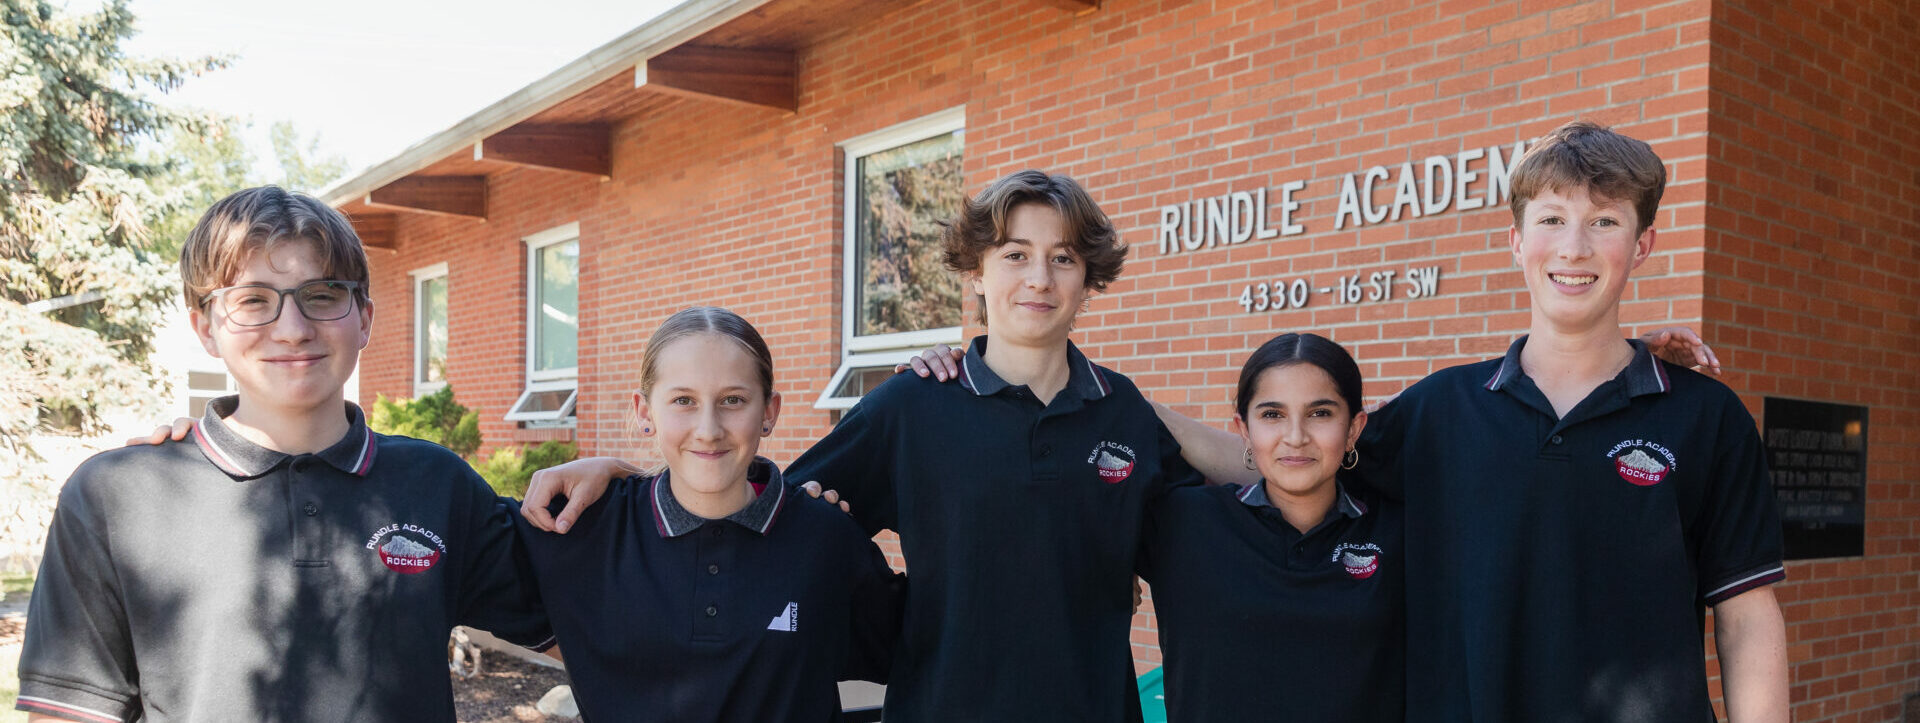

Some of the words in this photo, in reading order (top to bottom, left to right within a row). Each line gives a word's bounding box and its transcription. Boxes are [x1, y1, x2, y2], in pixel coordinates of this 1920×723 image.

[1159, 180, 1305, 255] RUNDLE
[1334, 138, 1538, 231] ACADEM
[1239, 279, 1308, 313] 4330
[1339, 275, 1362, 304] 16
[1369, 270, 1395, 302] ST
[1406, 266, 1439, 299] SW
[1107, 441, 1136, 462] ACADE
[1606, 439, 1643, 458] RUNDLE
[1645, 441, 1677, 472] ACADEMY
[1620, 466, 1661, 481] ROCKIES
[366, 523, 400, 550] RUNDLE
[402, 523, 447, 554] ACADEMY
[386, 556, 431, 567] ROCKIES
